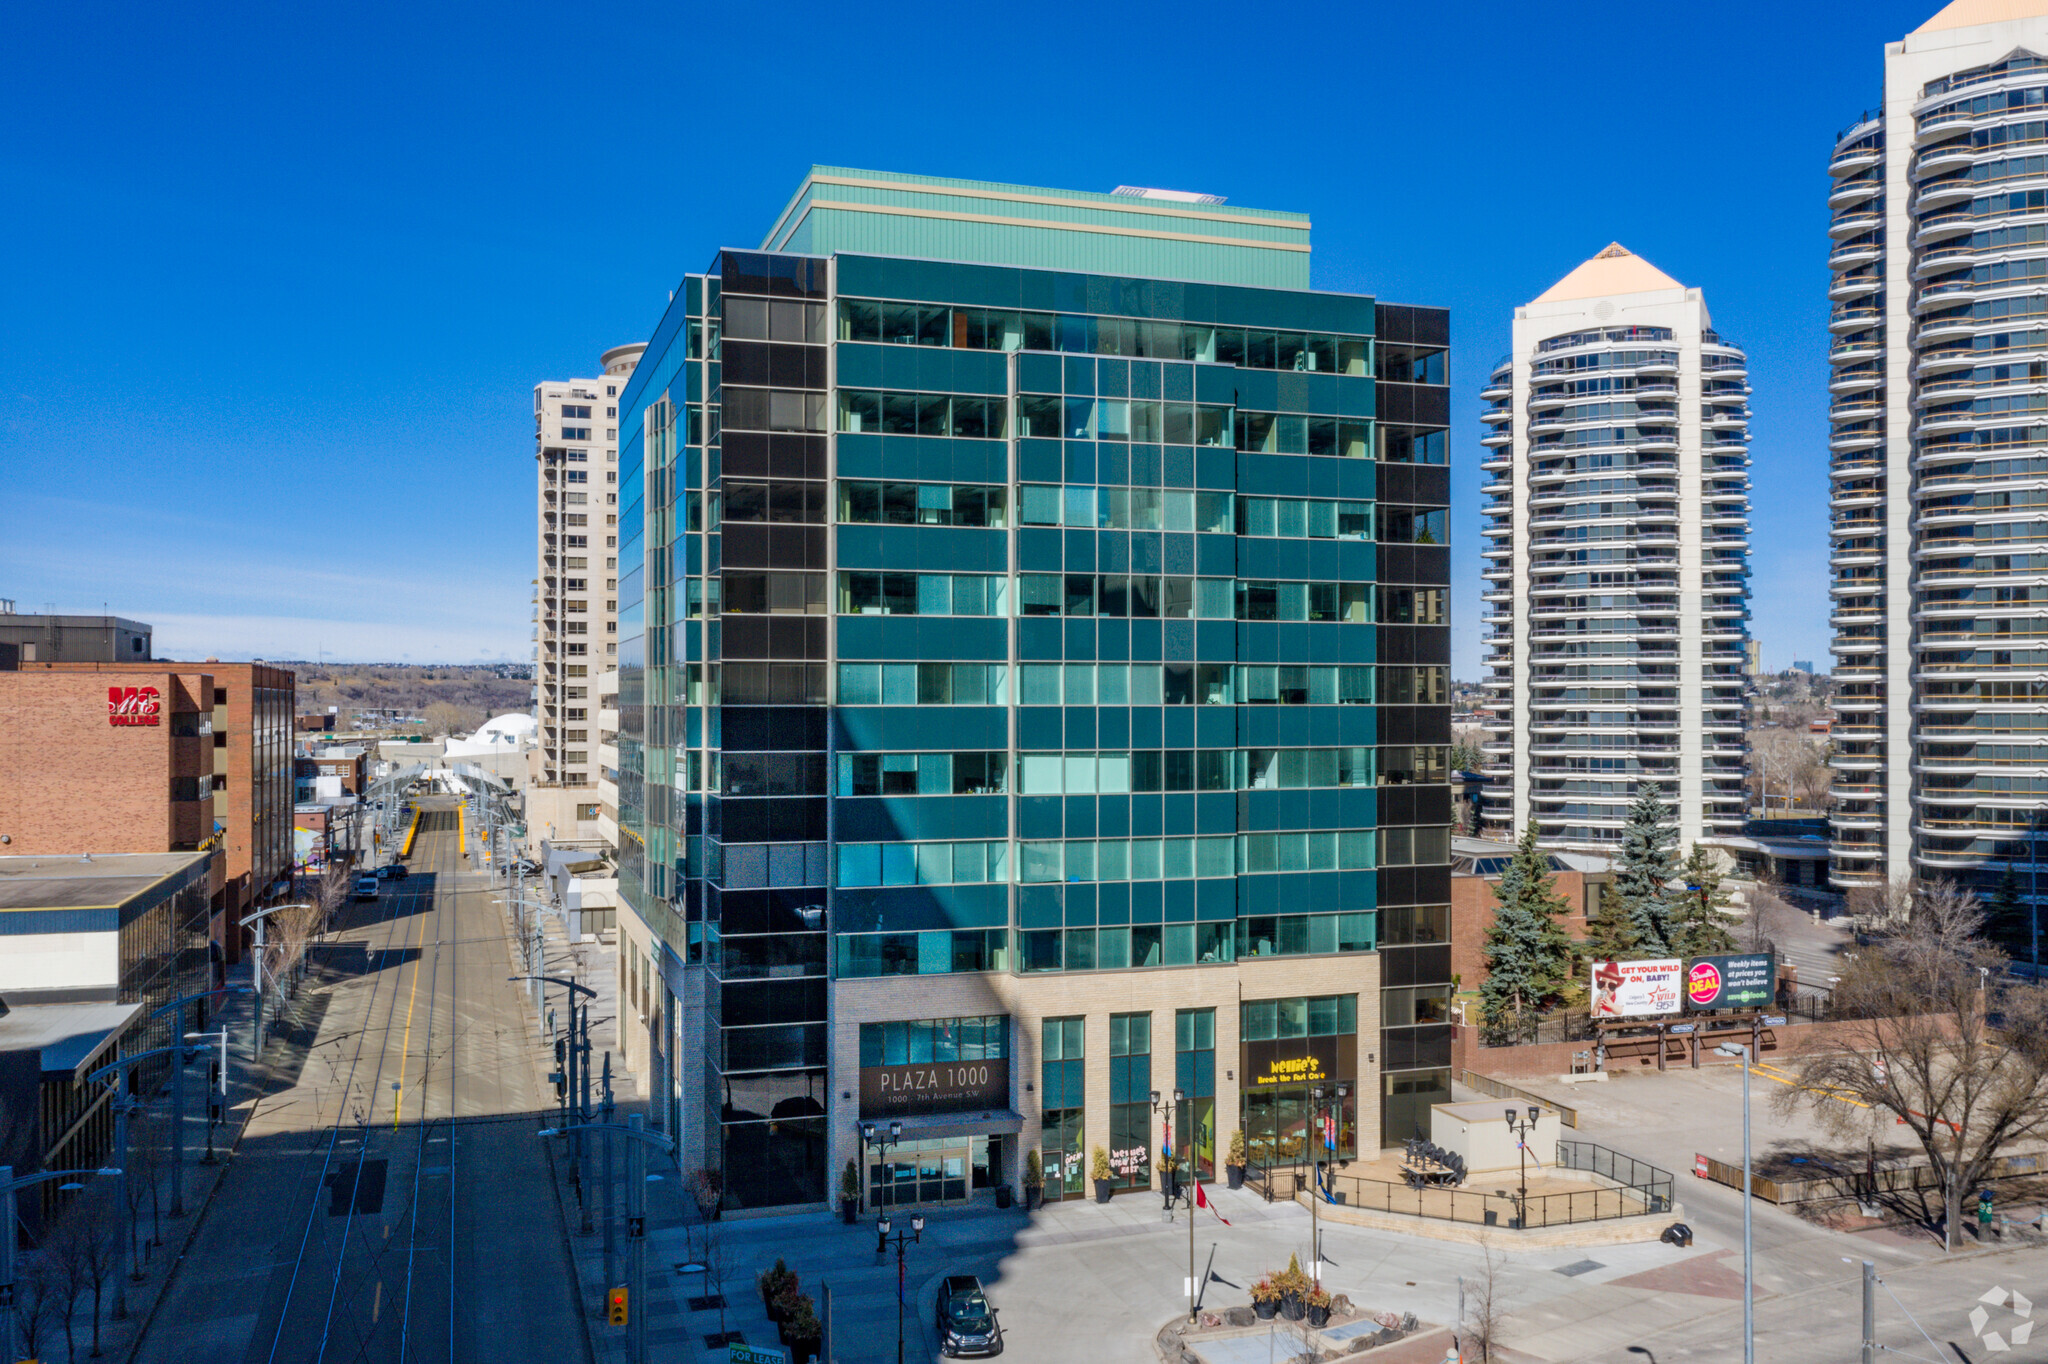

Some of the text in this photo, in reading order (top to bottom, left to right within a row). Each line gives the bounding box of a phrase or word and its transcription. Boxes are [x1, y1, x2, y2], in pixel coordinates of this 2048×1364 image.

[109, 715, 160, 726] COLLEGE
[1728, 961, 1750, 969] Weekly
[1621, 967, 1636, 975] GET
[1735, 970, 1754, 979] prices
[1754, 969, 1767, 977] you
[1630, 973, 1670, 983] ON, BABY!
[1689, 977, 1719, 994] DEAL
[1656, 992, 1676, 1001] WILD
[1271, 1056, 1319, 1073] Nellie's
[881, 1066, 988, 1092] PLAZA 1000
[1258, 1076, 1277, 1084] Break
[1280, 1074, 1291, 1082] the
[1293, 1073, 1306, 1081] Fast
[888, 1095, 907, 1103] 1000
[917, 1093, 930, 1101] 7th
[933, 1092, 962, 1100] Avenue
[731, 1350, 783, 1364] FOR LEASE
